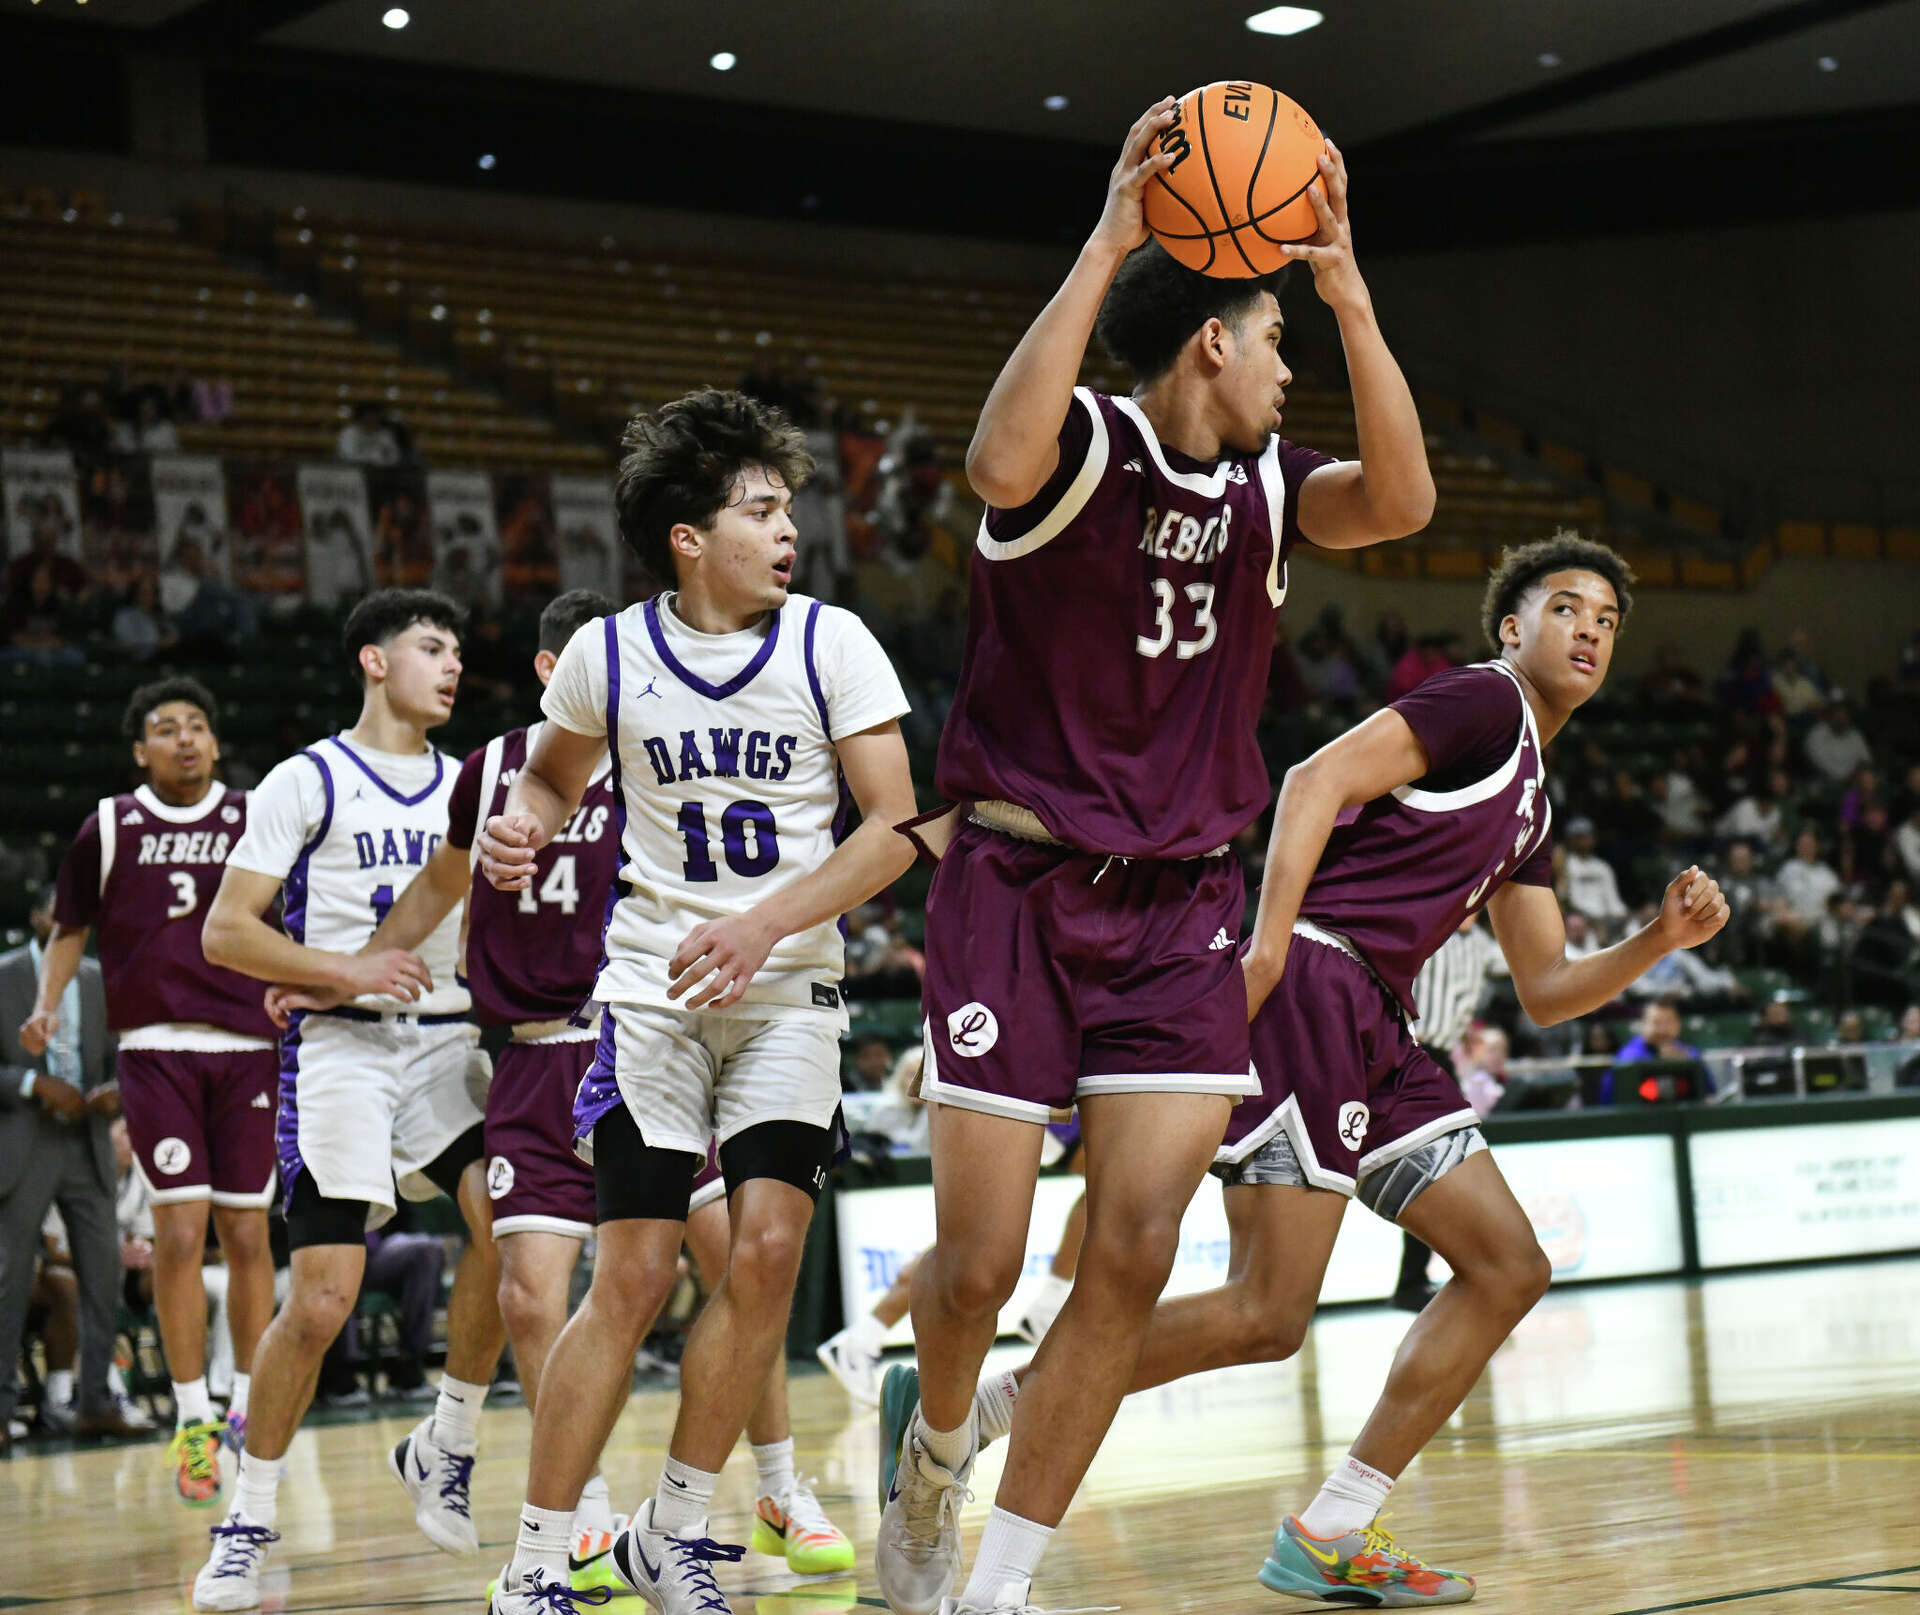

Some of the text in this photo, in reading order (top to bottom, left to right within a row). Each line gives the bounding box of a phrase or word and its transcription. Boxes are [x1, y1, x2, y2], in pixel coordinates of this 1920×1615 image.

[1223, 82, 1252, 122] EV
[1136, 577, 1219, 660] 33
[642, 727, 798, 786] DAWGS
[137, 831, 230, 865] REBELS
[353, 828, 442, 869] DAW
[676, 799, 780, 882] 10
[167, 870, 198, 919] 3
[517, 854, 580, 915] 14
[370, 884, 394, 936] 1
[952, 1011, 988, 1047] L
[1342, 1110, 1366, 1142] L
[811, 1164, 827, 1191] 10
